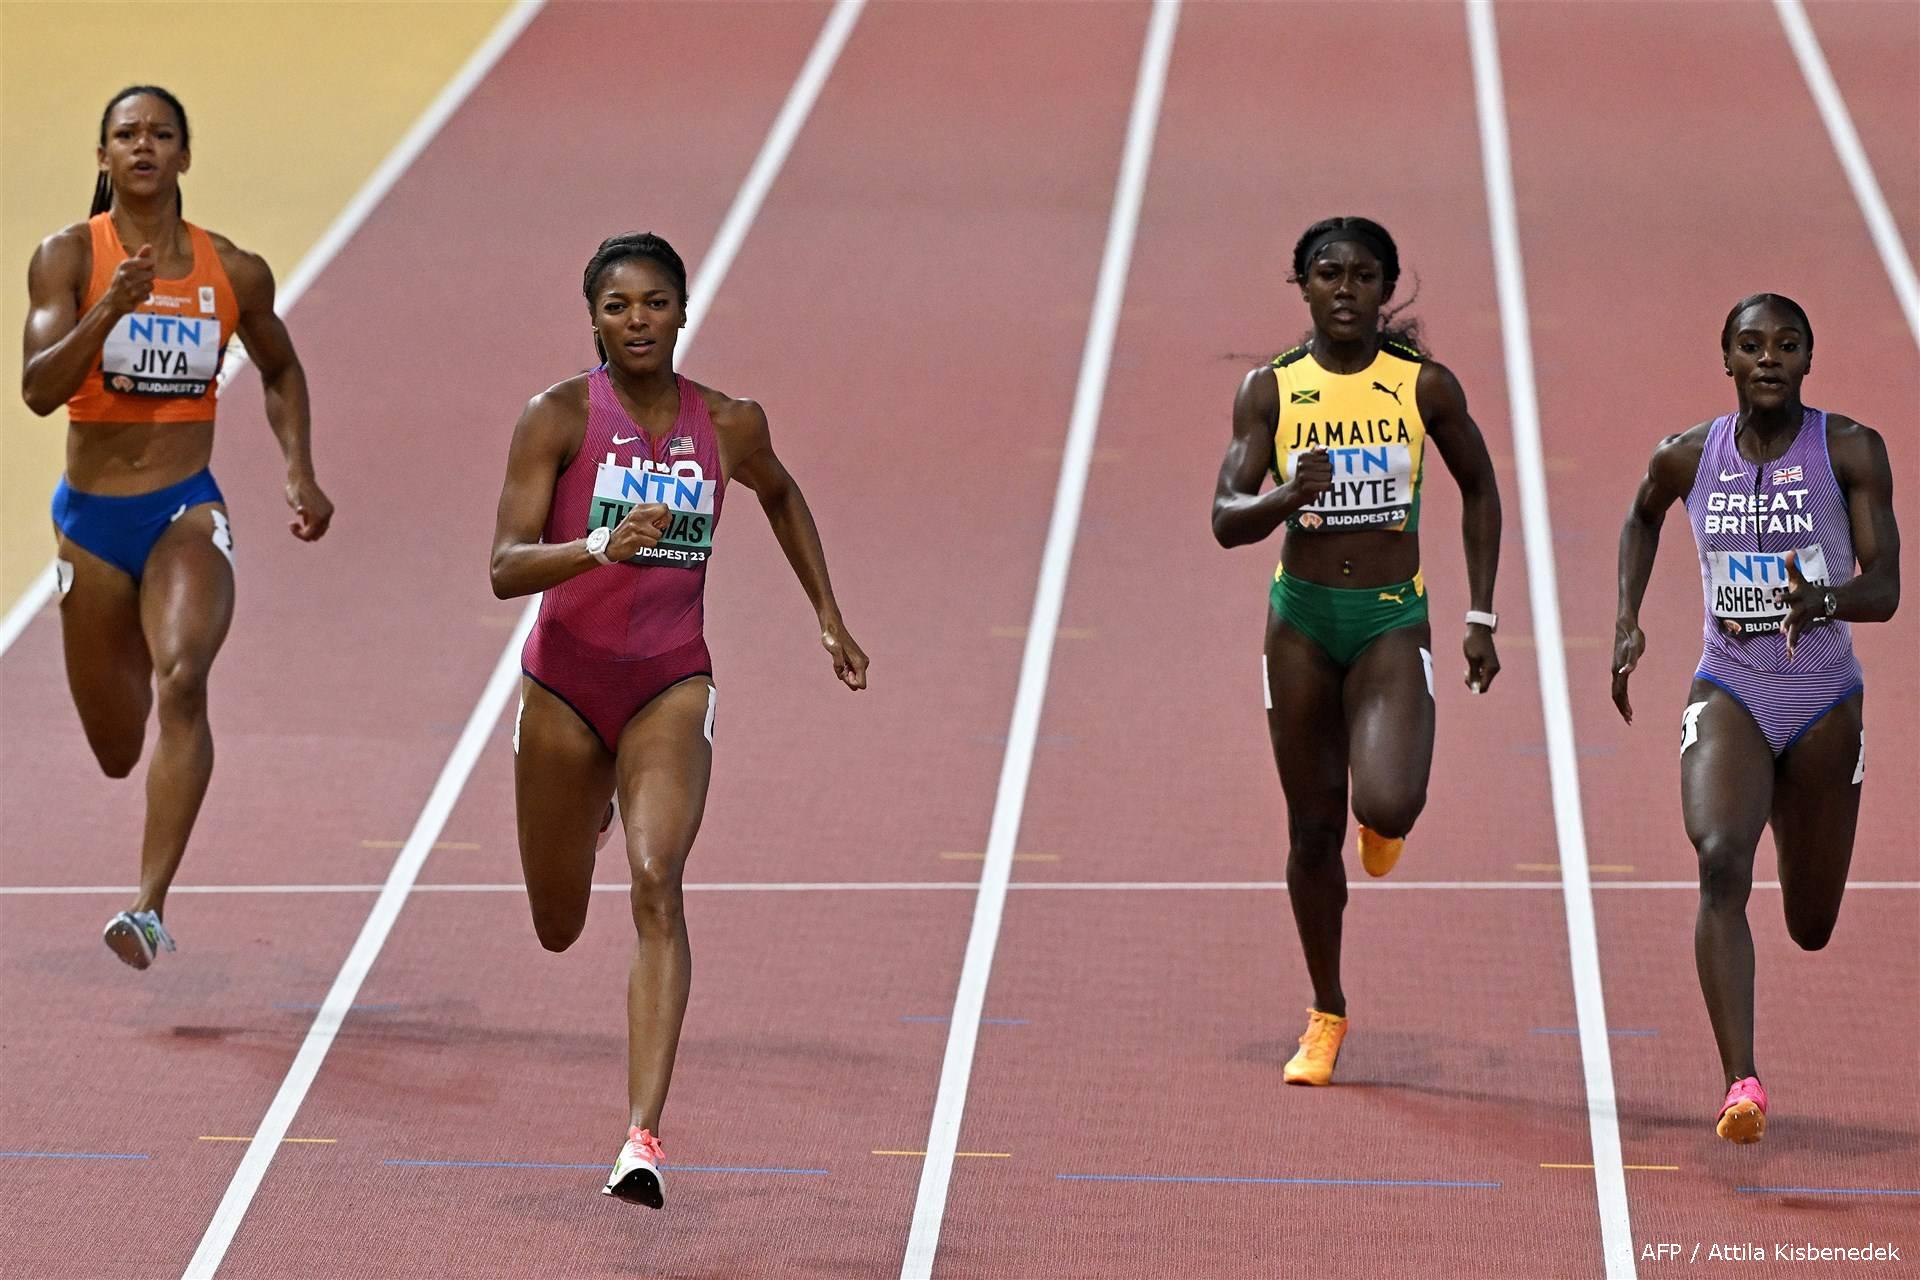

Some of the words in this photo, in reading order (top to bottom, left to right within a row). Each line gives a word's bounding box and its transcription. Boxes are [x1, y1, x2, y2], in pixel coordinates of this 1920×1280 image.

[129, 316, 201, 347] NTN
[133, 348, 189, 375] JIYA
[137, 381, 192, 393] BUDAPEST
[1290, 417, 1410, 449] JAMAICA
[621, 469, 703, 510] NTN
[1707, 489, 1809, 513] GREAT
[599, 501, 706, 543] THAS
[1326, 511, 1389, 526] BUDAPEST
[1391, 509, 1406, 520] 23
[1704, 513, 1813, 535] BRITAIN
[635, 546, 689, 561] UDAPEST
[690, 551, 706, 562] 23
